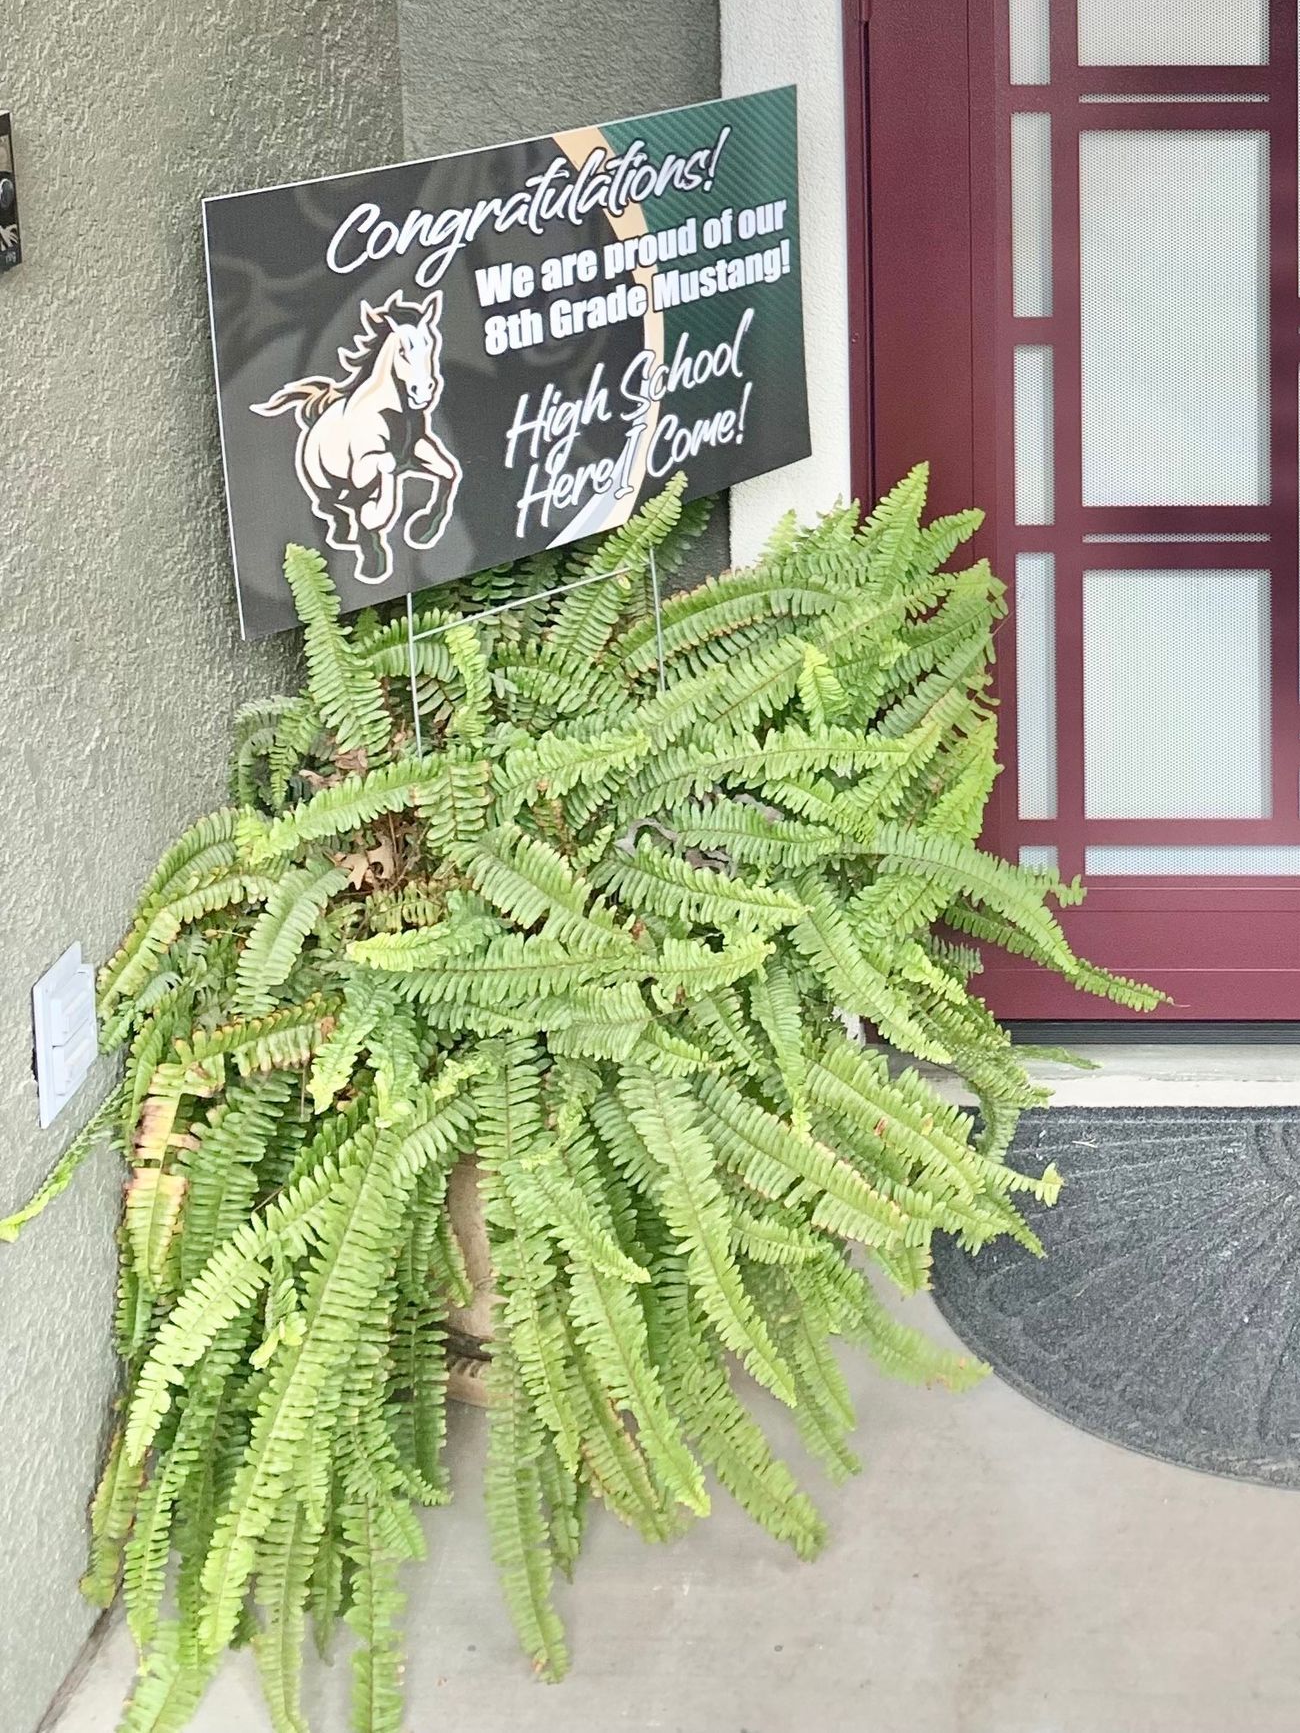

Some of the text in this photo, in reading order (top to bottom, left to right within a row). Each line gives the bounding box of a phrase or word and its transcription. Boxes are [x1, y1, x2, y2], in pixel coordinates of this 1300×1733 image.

[327, 126, 732, 286] Congratulations!
[474, 198, 789, 308] We are proud of our
[484, 238, 793, 356] 8th Grade Mustang!
[504, 307, 755, 469] High School
[515, 456, 614, 538] Here
[646, 382, 753, 477] Come!
